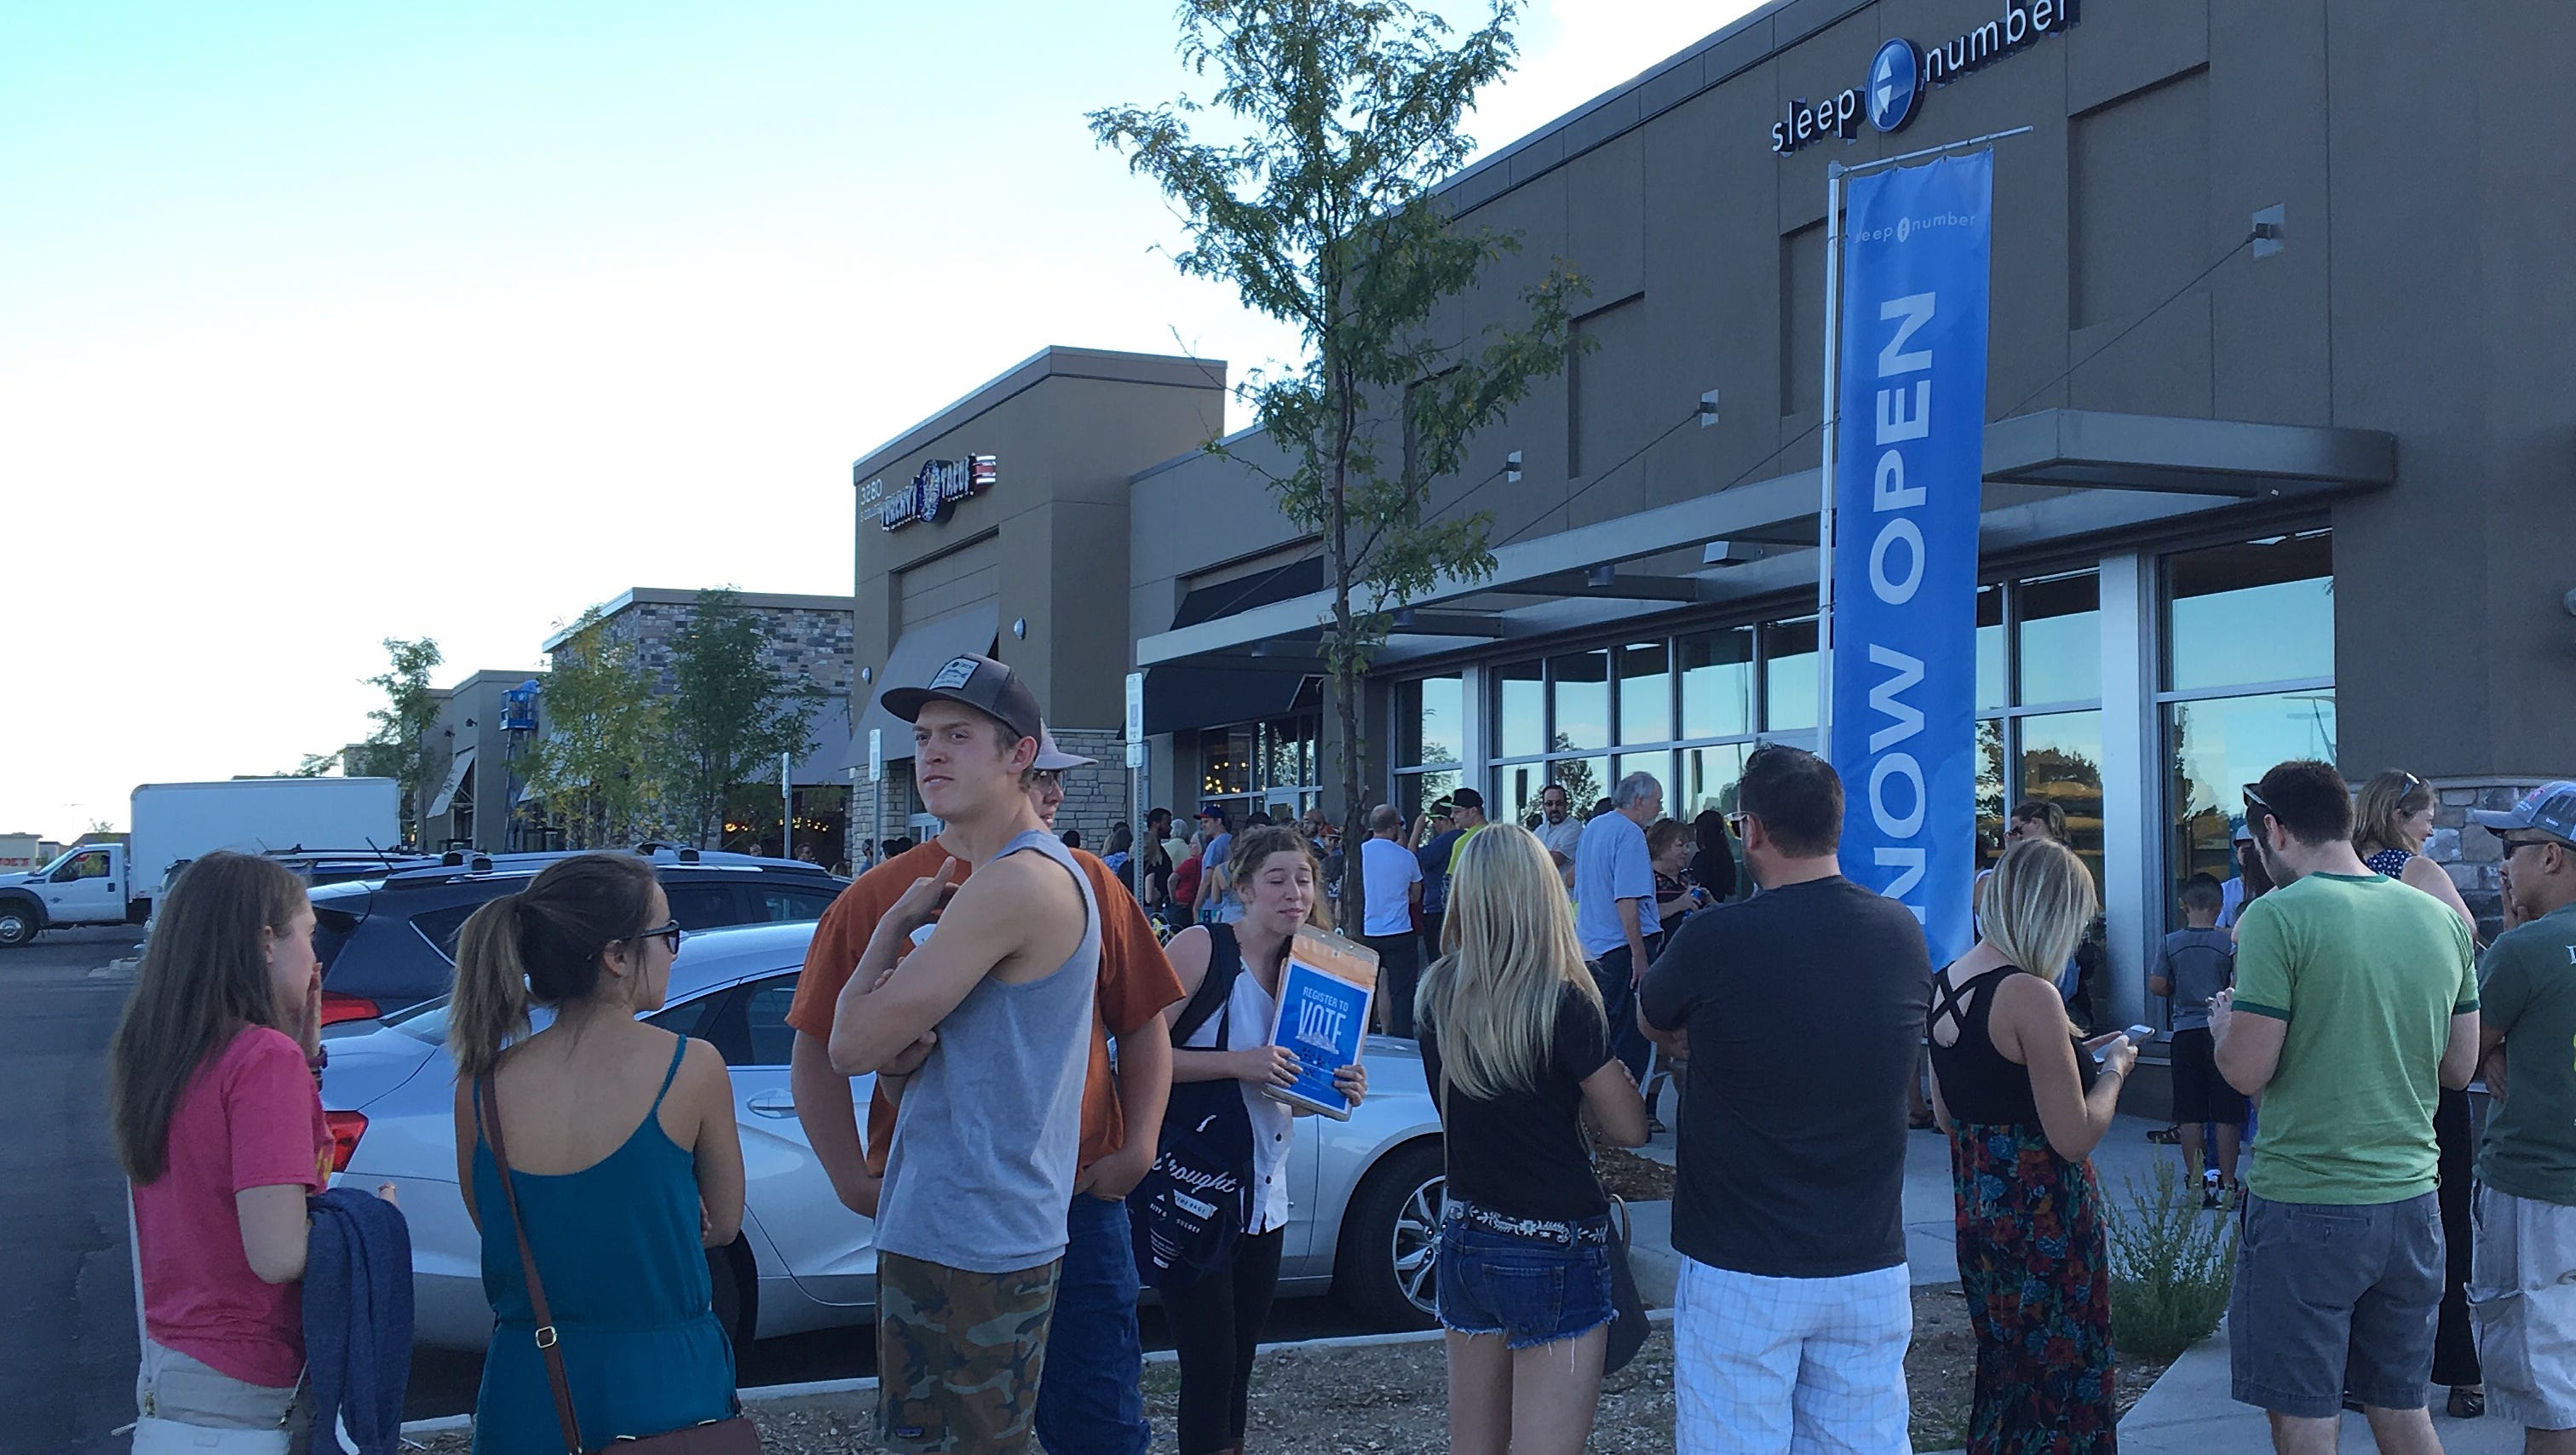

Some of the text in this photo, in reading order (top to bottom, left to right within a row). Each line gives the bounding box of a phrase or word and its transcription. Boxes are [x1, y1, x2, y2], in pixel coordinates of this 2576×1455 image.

[1772, 89, 1855, 152] sleep
[1912, 211, 1975, 230] number
[860, 478, 883, 505] 3280
[1869, 290, 1935, 925] NOW OPEN
[1302, 986, 1348, 1012] REGISTER TO
[1297, 998, 1346, 1055] VOTE
